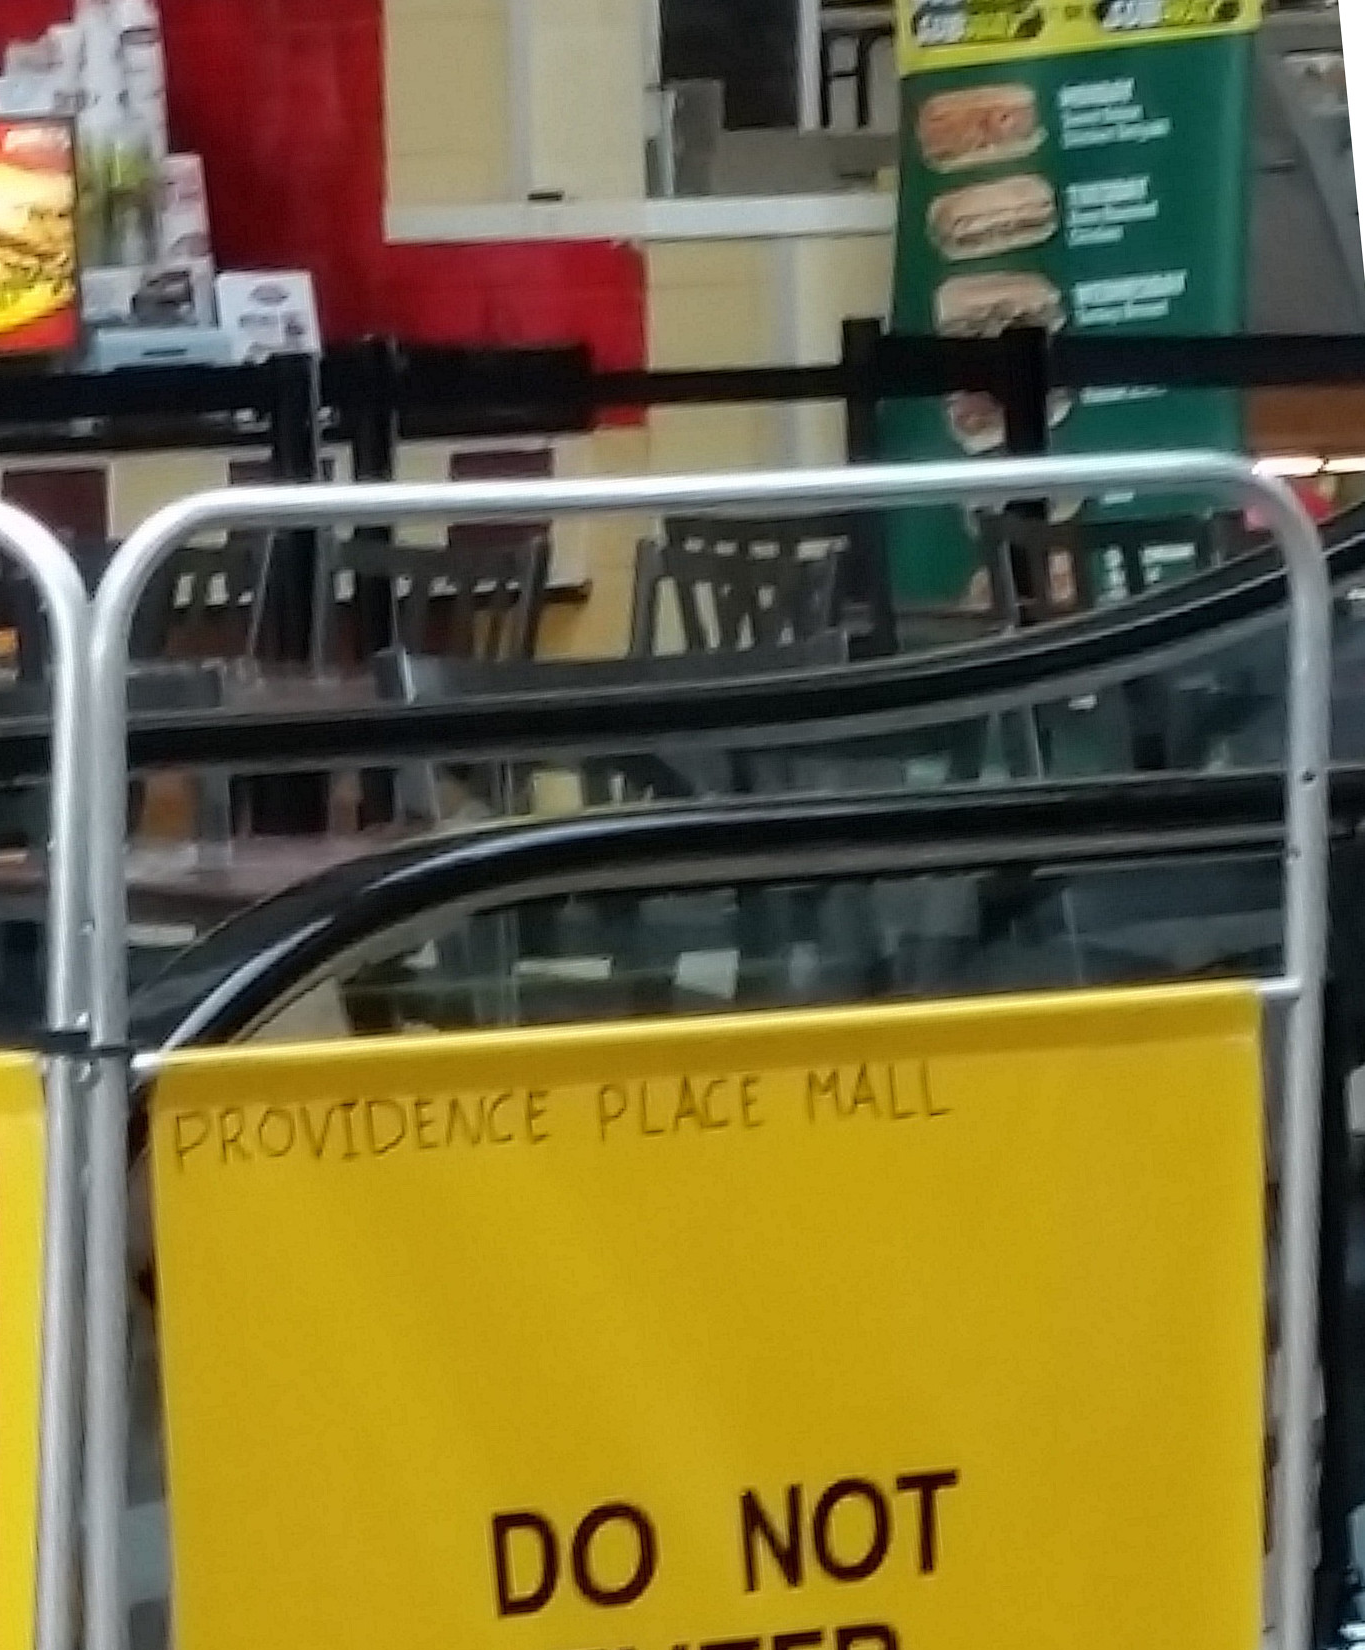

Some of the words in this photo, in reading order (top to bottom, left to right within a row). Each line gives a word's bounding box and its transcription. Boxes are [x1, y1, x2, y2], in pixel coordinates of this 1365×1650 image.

[175, 1089, 551, 1172] PROVIDENCE
[598, 1074, 763, 1142] PLACE
[806, 1060, 954, 1126] MALL
[492, 1502, 657, 1619] DO
[740, 1469, 958, 1594] NOT
